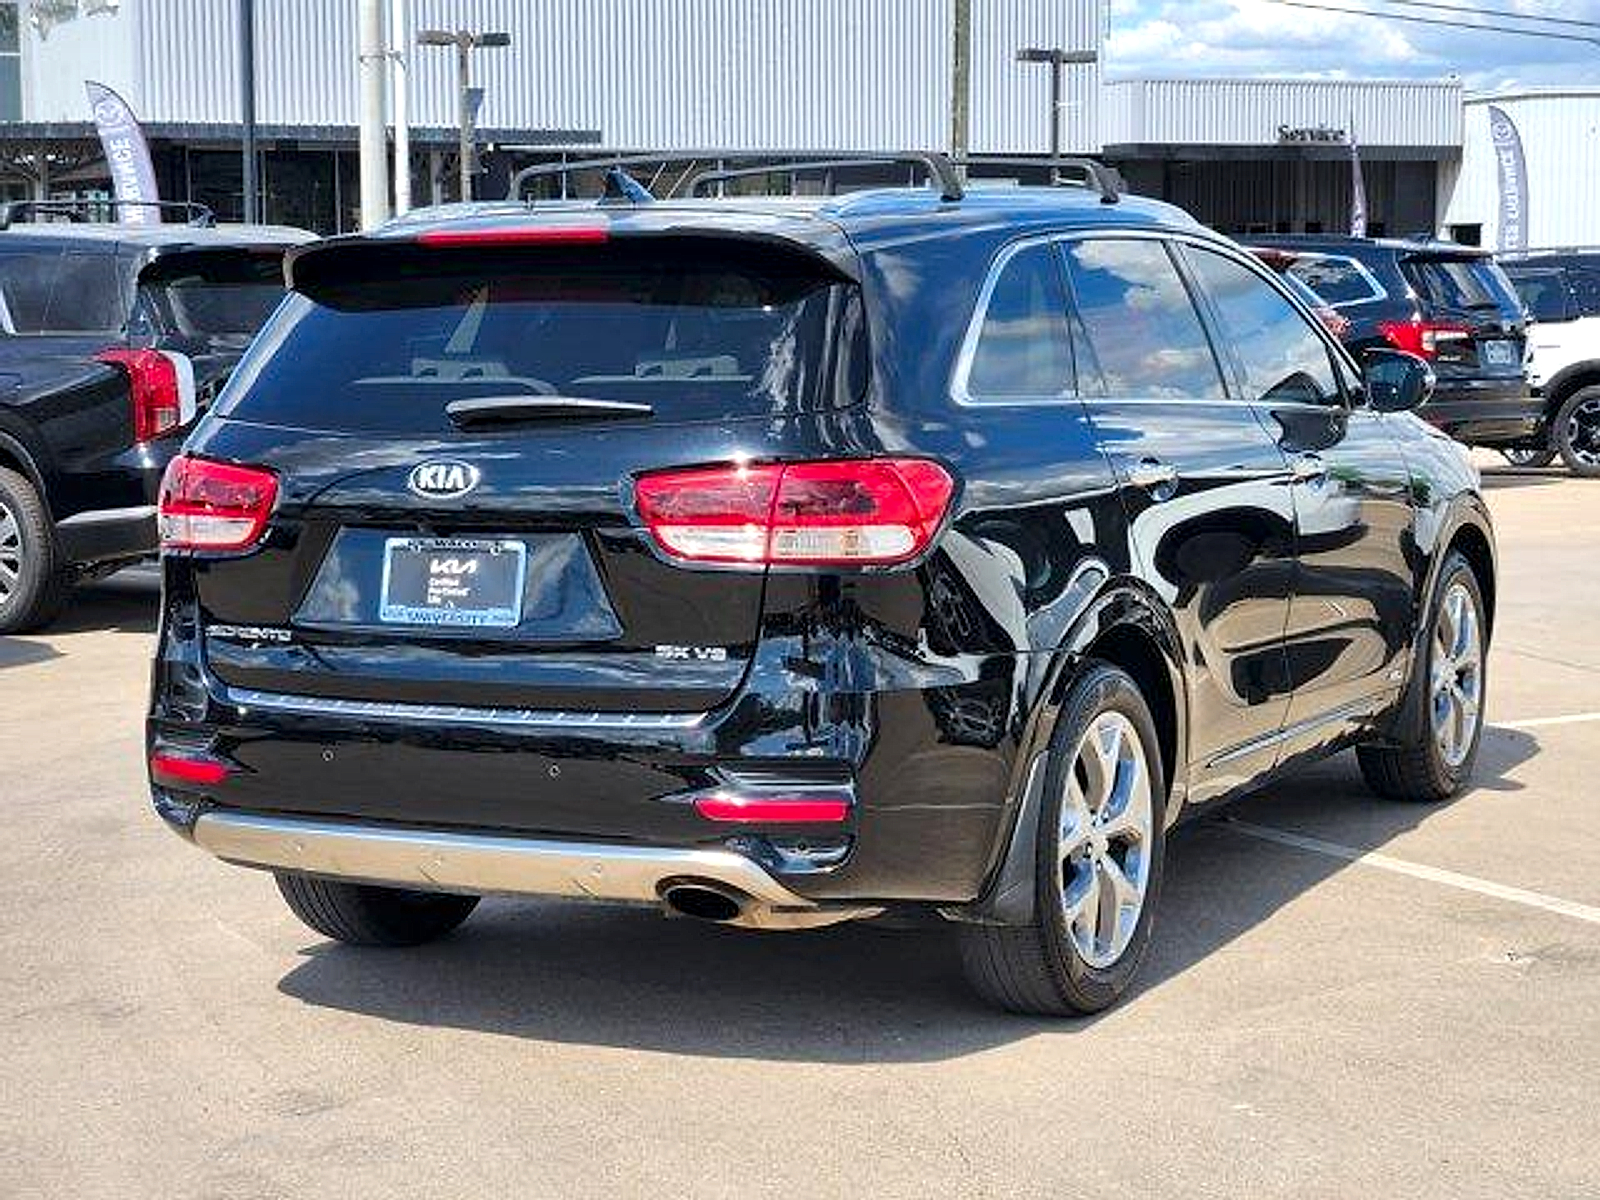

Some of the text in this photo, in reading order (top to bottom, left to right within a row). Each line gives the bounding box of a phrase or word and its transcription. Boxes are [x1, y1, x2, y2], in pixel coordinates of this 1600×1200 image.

[1278, 124, 1345, 141] Service
[420, 465, 465, 489] KIA
[430, 559, 477, 574] KIA
